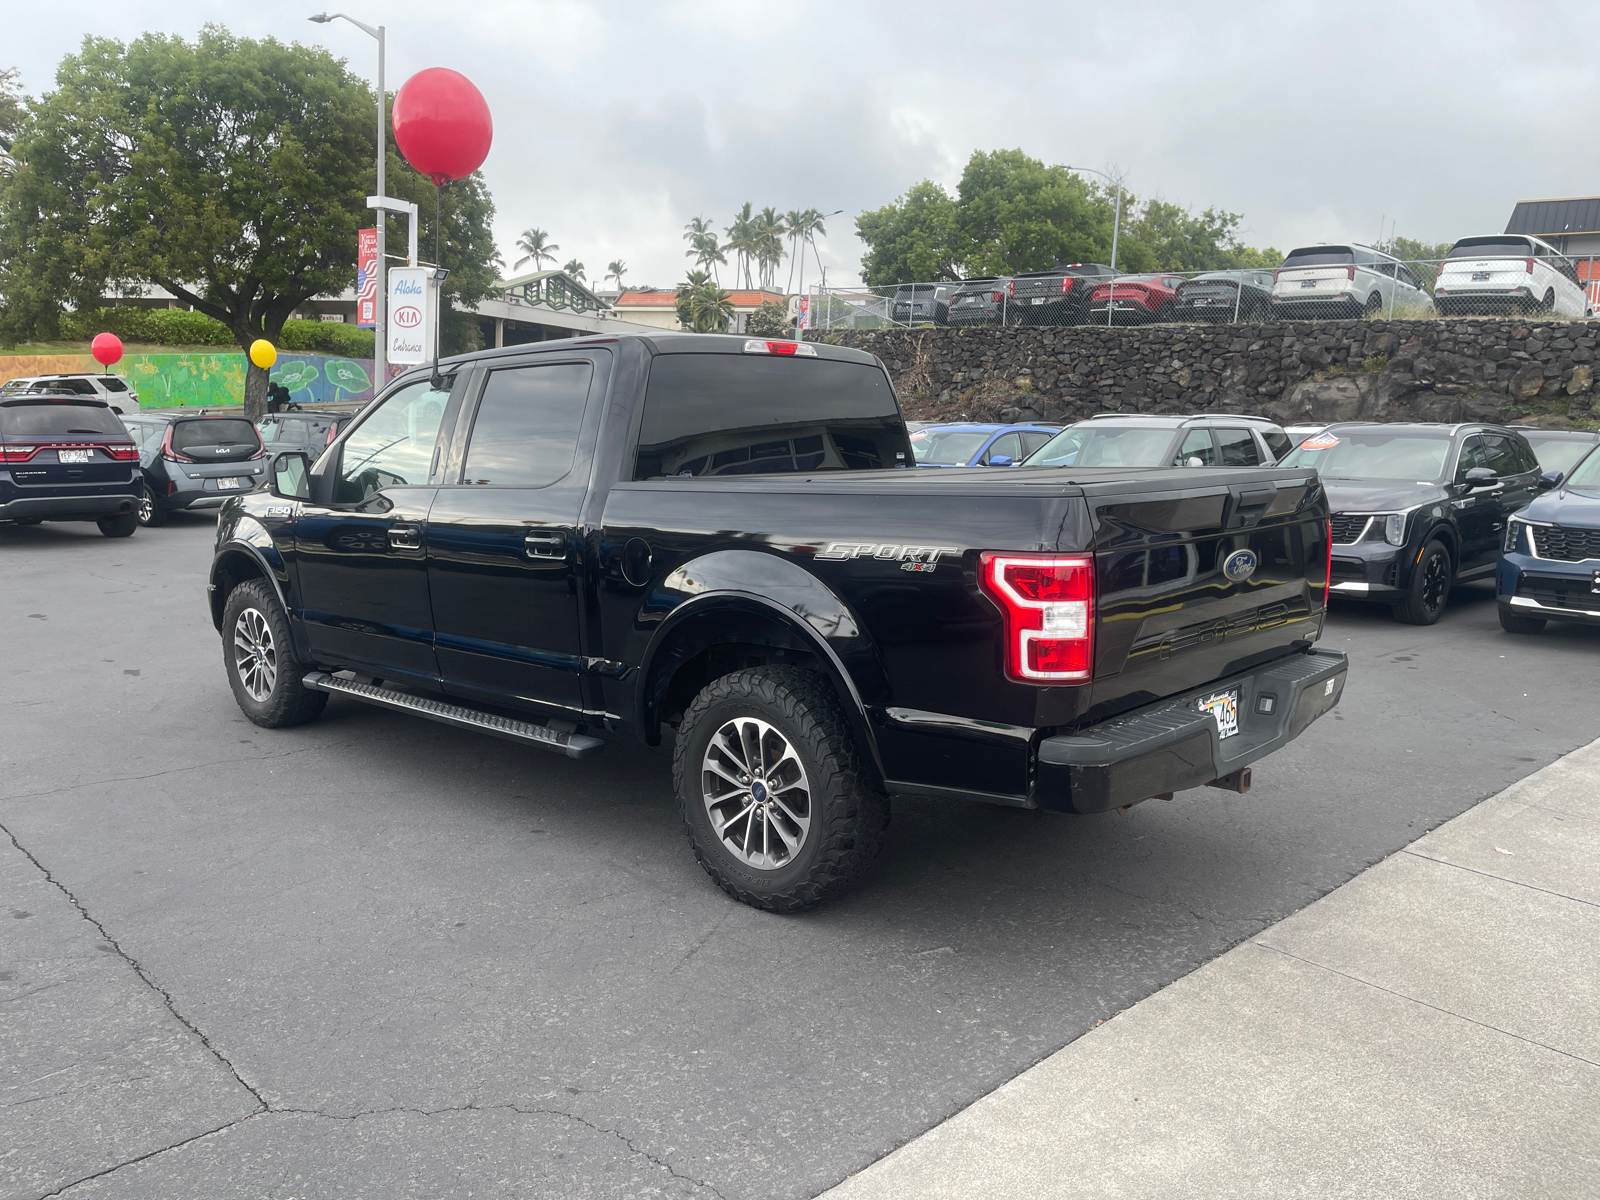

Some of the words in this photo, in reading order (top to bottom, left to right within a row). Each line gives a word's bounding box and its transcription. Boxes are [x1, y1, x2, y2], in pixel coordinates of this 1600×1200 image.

[394, 279, 422, 295] Aloha
[398, 311, 417, 323] KIA
[393, 338, 422, 352] Entrance
[813, 541, 958, 563] SPORT
[1233, 556, 1253, 575] Ford
[1220, 698, 1236, 727] 465
